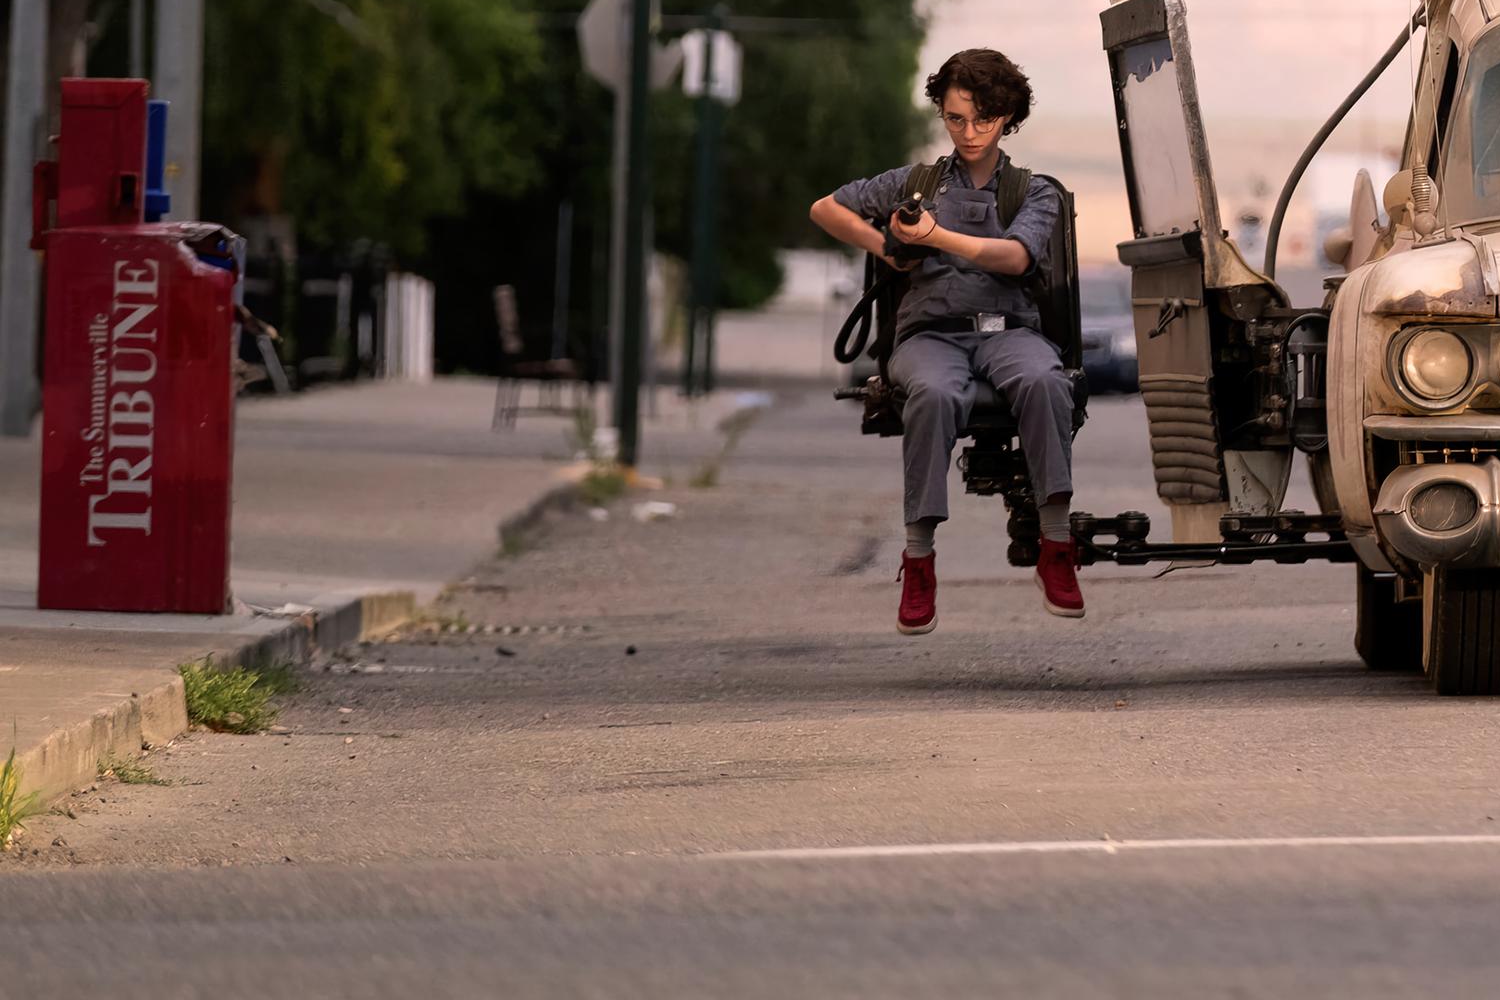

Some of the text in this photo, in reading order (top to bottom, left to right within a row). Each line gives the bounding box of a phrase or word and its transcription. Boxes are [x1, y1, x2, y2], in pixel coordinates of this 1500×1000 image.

[80, 312, 109, 487] The Summerville
[88, 258, 160, 547] TRIBUNE
